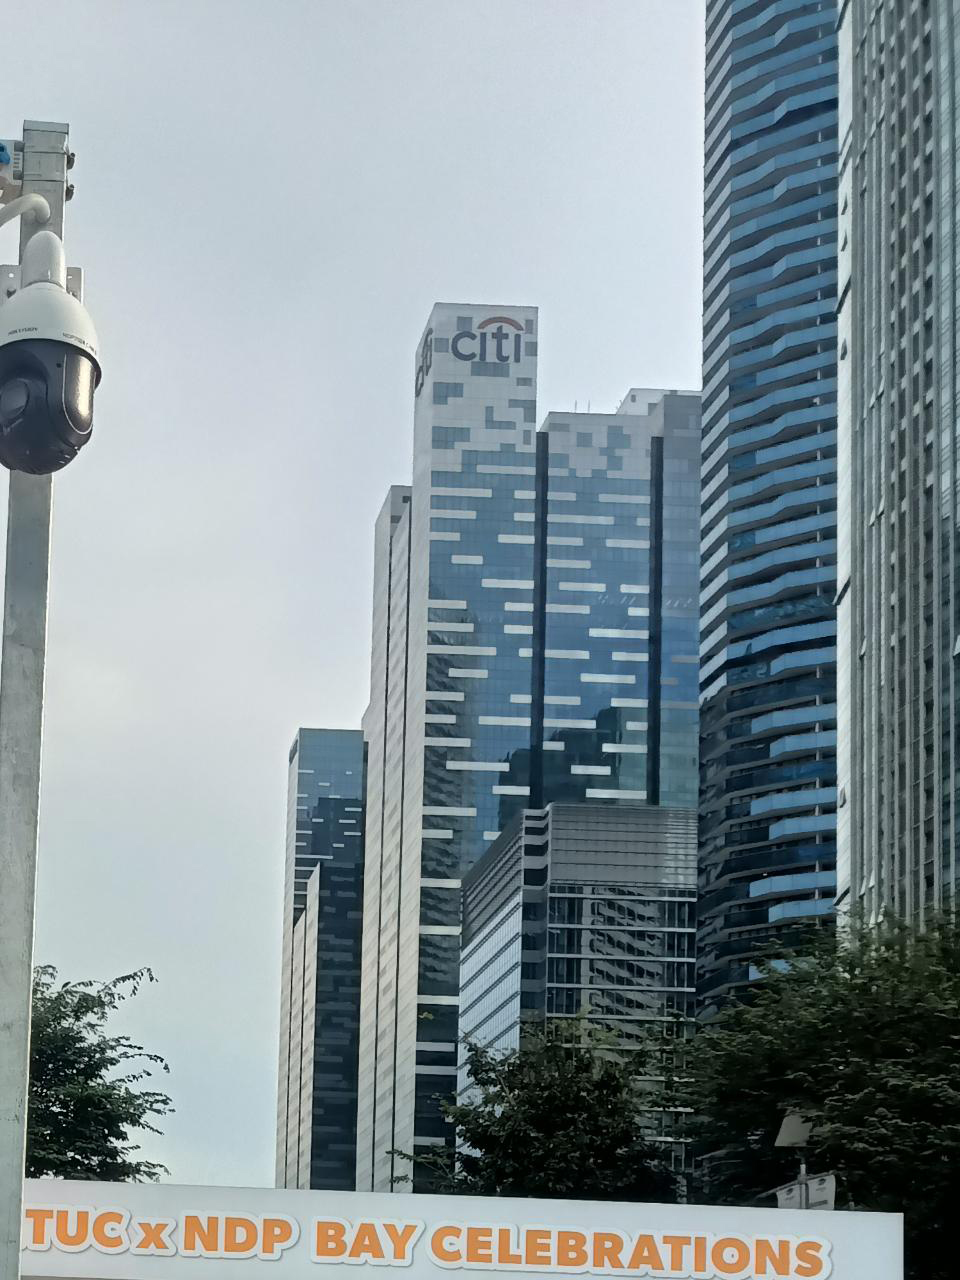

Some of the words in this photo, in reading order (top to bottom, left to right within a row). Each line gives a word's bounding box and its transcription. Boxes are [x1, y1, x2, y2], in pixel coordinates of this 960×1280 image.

[451, 316, 524, 363] citi
[25, 1209, 125, 1249] TUC
[137, 1222, 169, 1250] x
[183, 1214, 292, 1254] NDP
[316, 1220, 418, 1260] BAY
[431, 1225, 823, 1278] CELEBRATIONS
